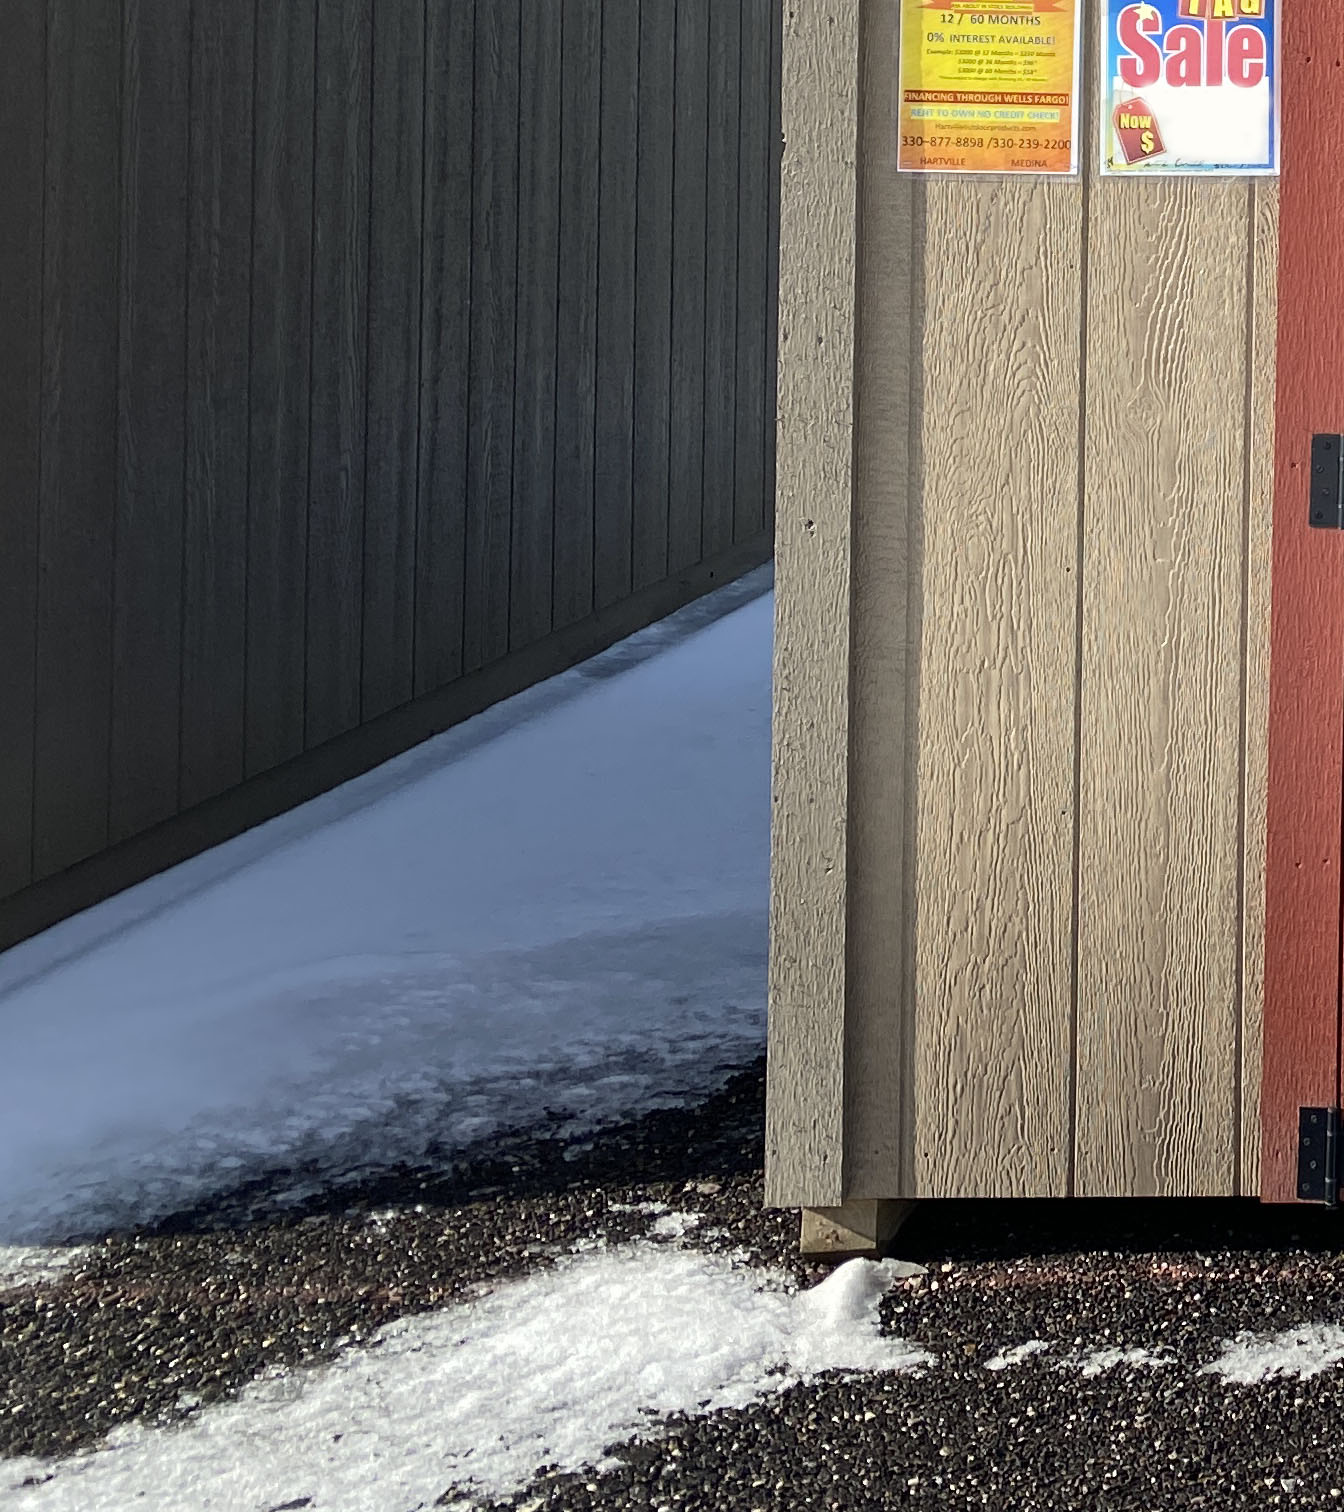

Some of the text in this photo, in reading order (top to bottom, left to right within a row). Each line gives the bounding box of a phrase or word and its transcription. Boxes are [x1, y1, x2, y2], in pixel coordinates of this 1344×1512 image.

[940, 13, 1041, 26] 12 / 60 MONTHS
[927, 32, 1056, 45] 0% INTEREST AVAILABLE!
[1117, 3, 1266, 88] Sale
[904, 92, 1069, 105] FINANCING THROUGH WELLS FARGO!
[911, 108, 1059, 120] RENT TO OWN NO CREDIT CHECK!
[1140, 130, 1154, 155] $
[920, 157, 1048, 168] HARTVILLE MEDINA
